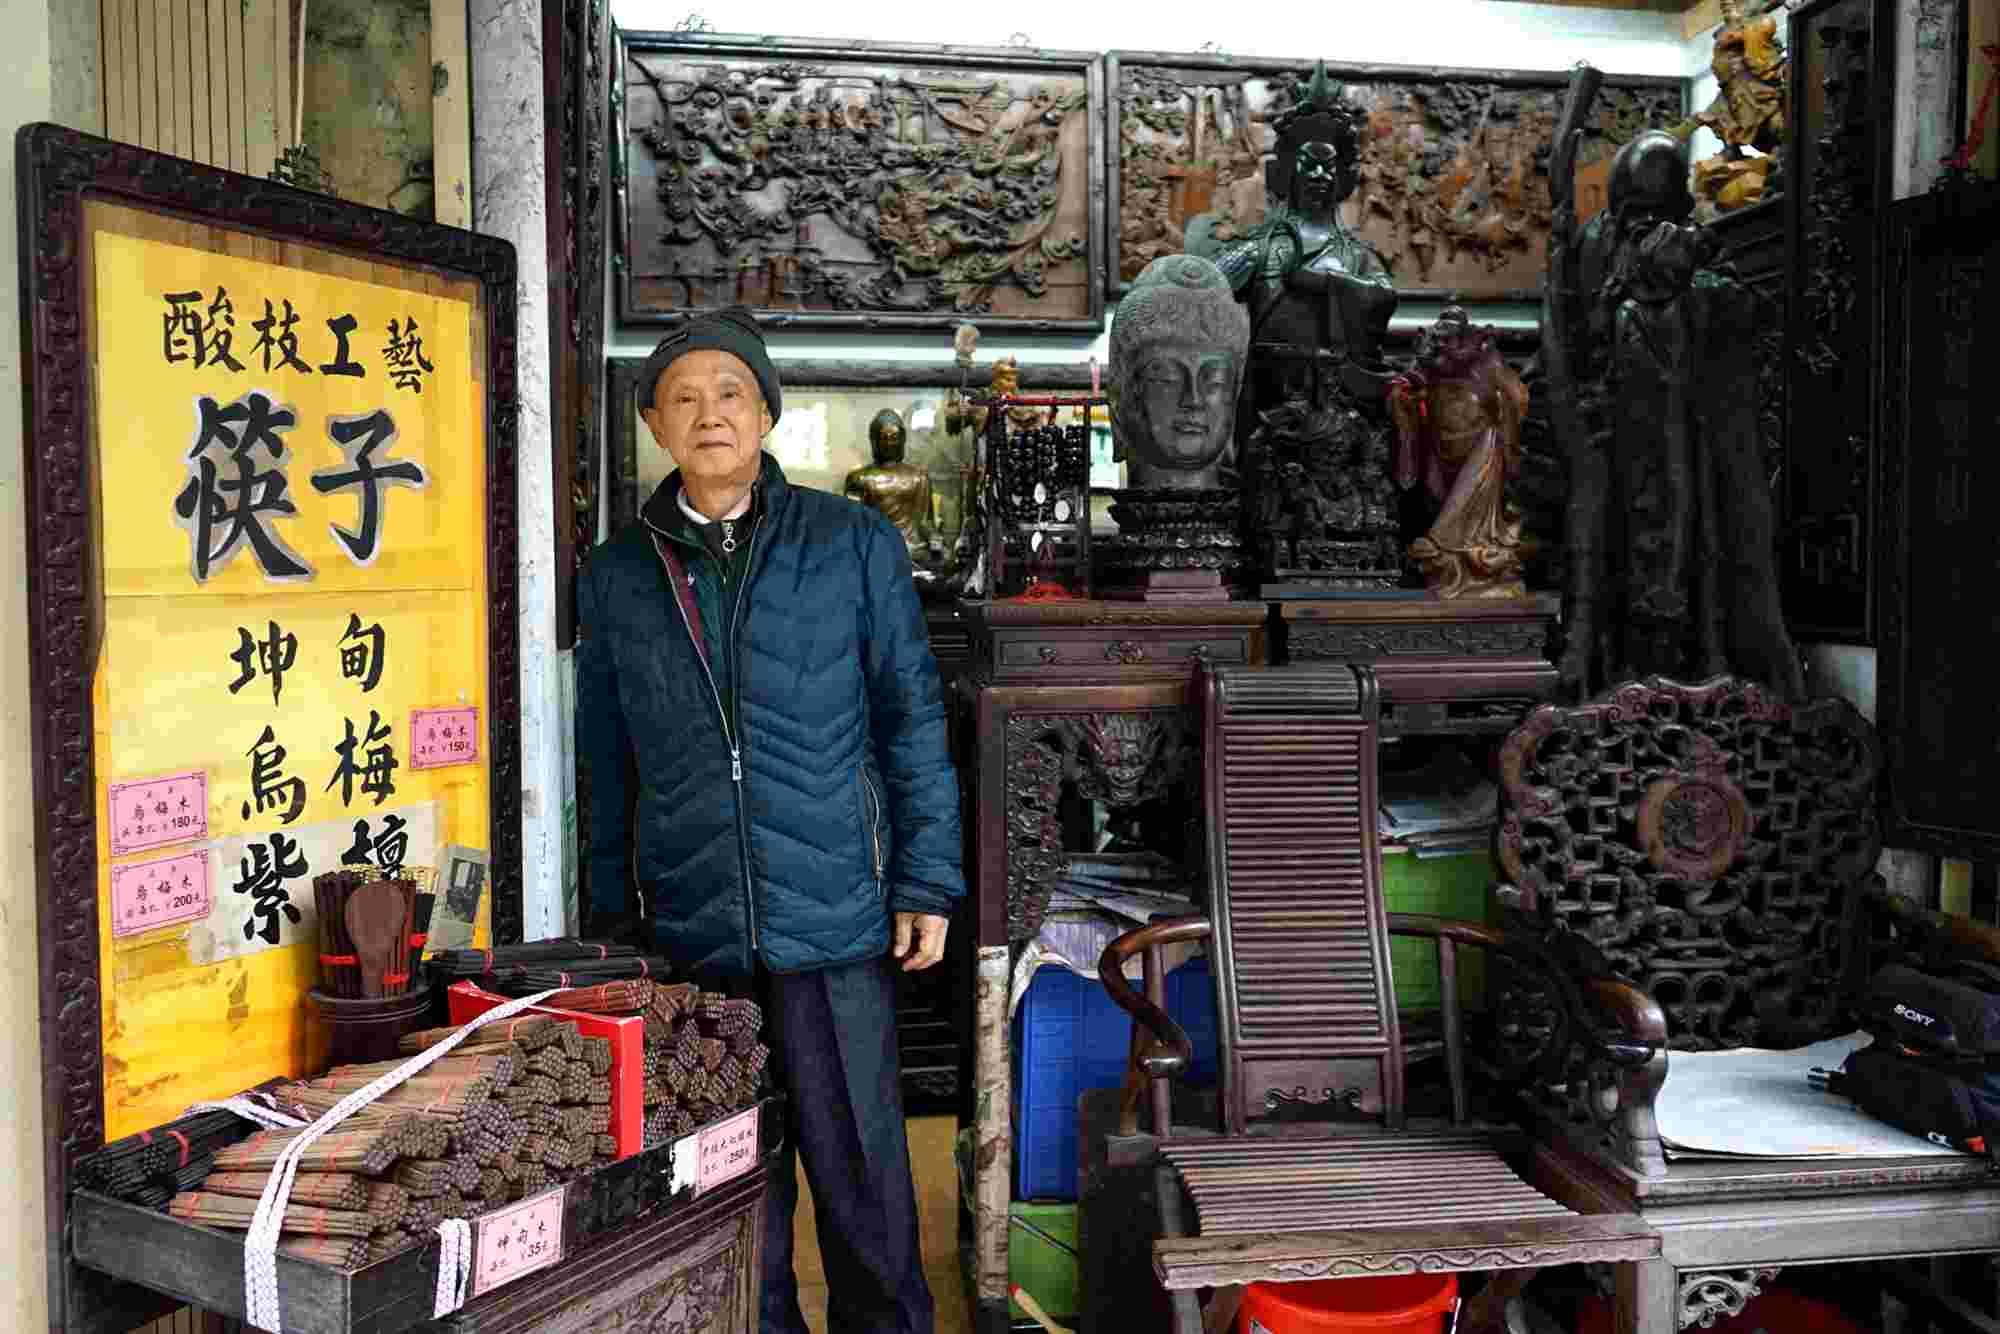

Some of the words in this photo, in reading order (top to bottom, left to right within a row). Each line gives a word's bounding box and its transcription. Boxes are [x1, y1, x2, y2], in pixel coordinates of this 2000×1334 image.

[161, 286, 434, 393] 酸枝工藝
[174, 391, 429, 582] 筷子
[228, 613, 386, 707] 坤甸
[1894, 1004, 1934, 1026] SONY
